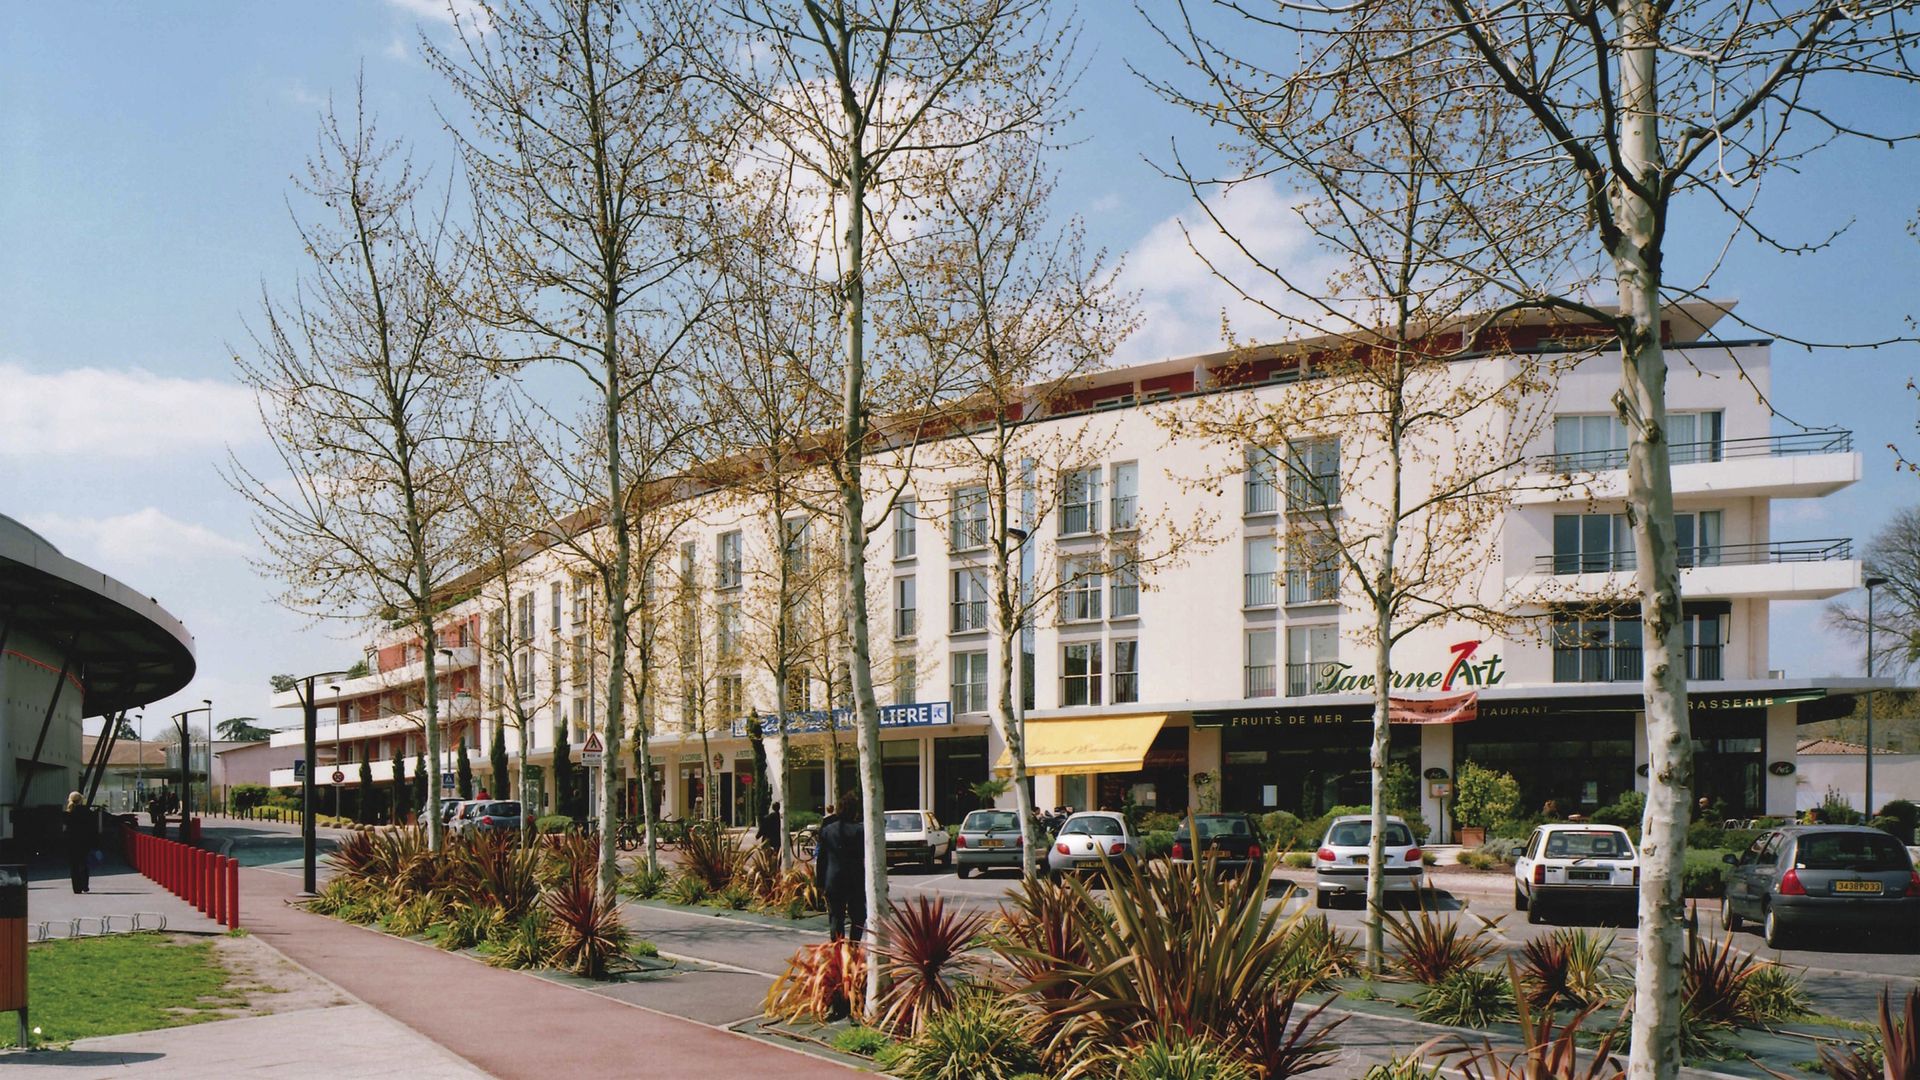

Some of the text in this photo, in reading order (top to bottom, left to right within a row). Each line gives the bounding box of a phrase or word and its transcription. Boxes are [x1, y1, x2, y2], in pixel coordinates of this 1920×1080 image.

[1316, 661, 1442, 692] Tavrne
[1688, 697, 1774, 710] RASSERIE
[838, 706, 928, 728] HOLIERE
[1481, 705, 1549, 717] TAURANT
[1232, 713, 1343, 727] FRUITS DE MER
